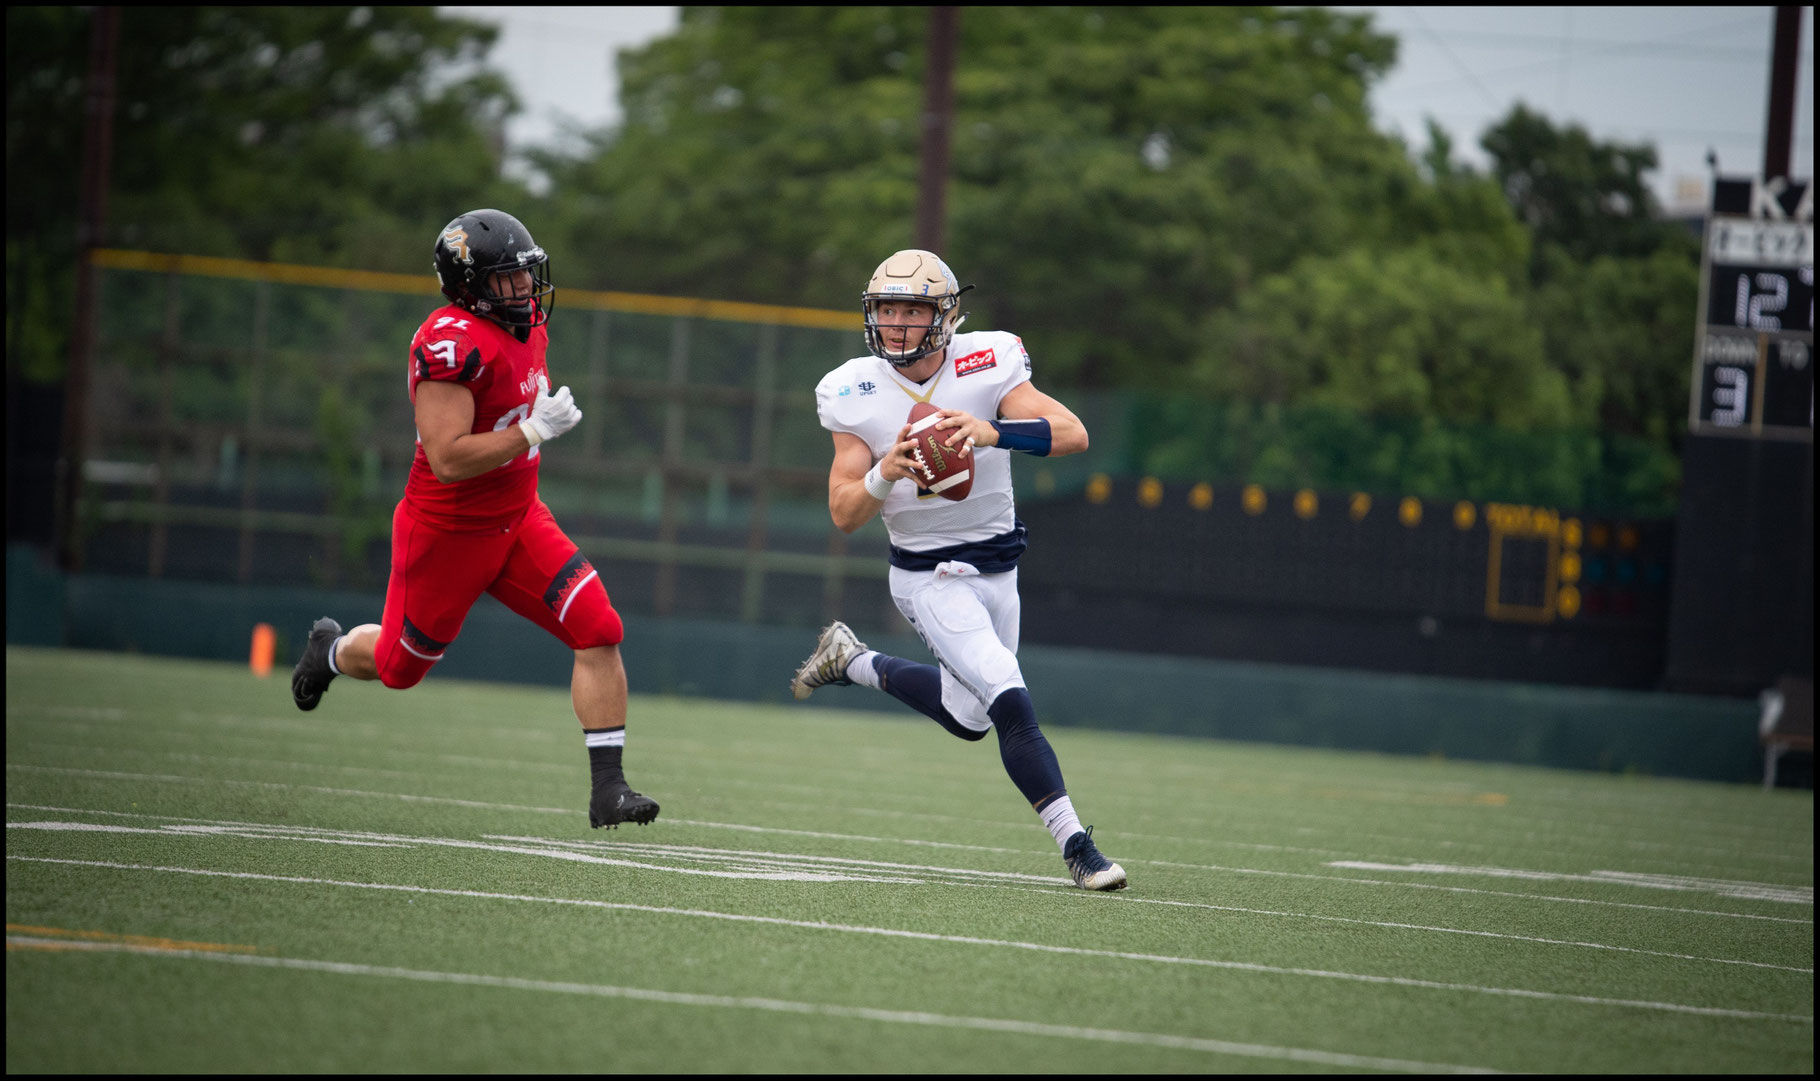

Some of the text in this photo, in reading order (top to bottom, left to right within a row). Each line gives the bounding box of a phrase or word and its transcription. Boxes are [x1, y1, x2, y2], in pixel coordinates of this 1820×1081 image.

[921, 283, 929, 296] 3
[1735, 272, 1789, 333] 12
[957, 351, 993, 371] オービック
[1711, 366, 1748, 428] 3
[927, 434, 947, 472] Wilson
